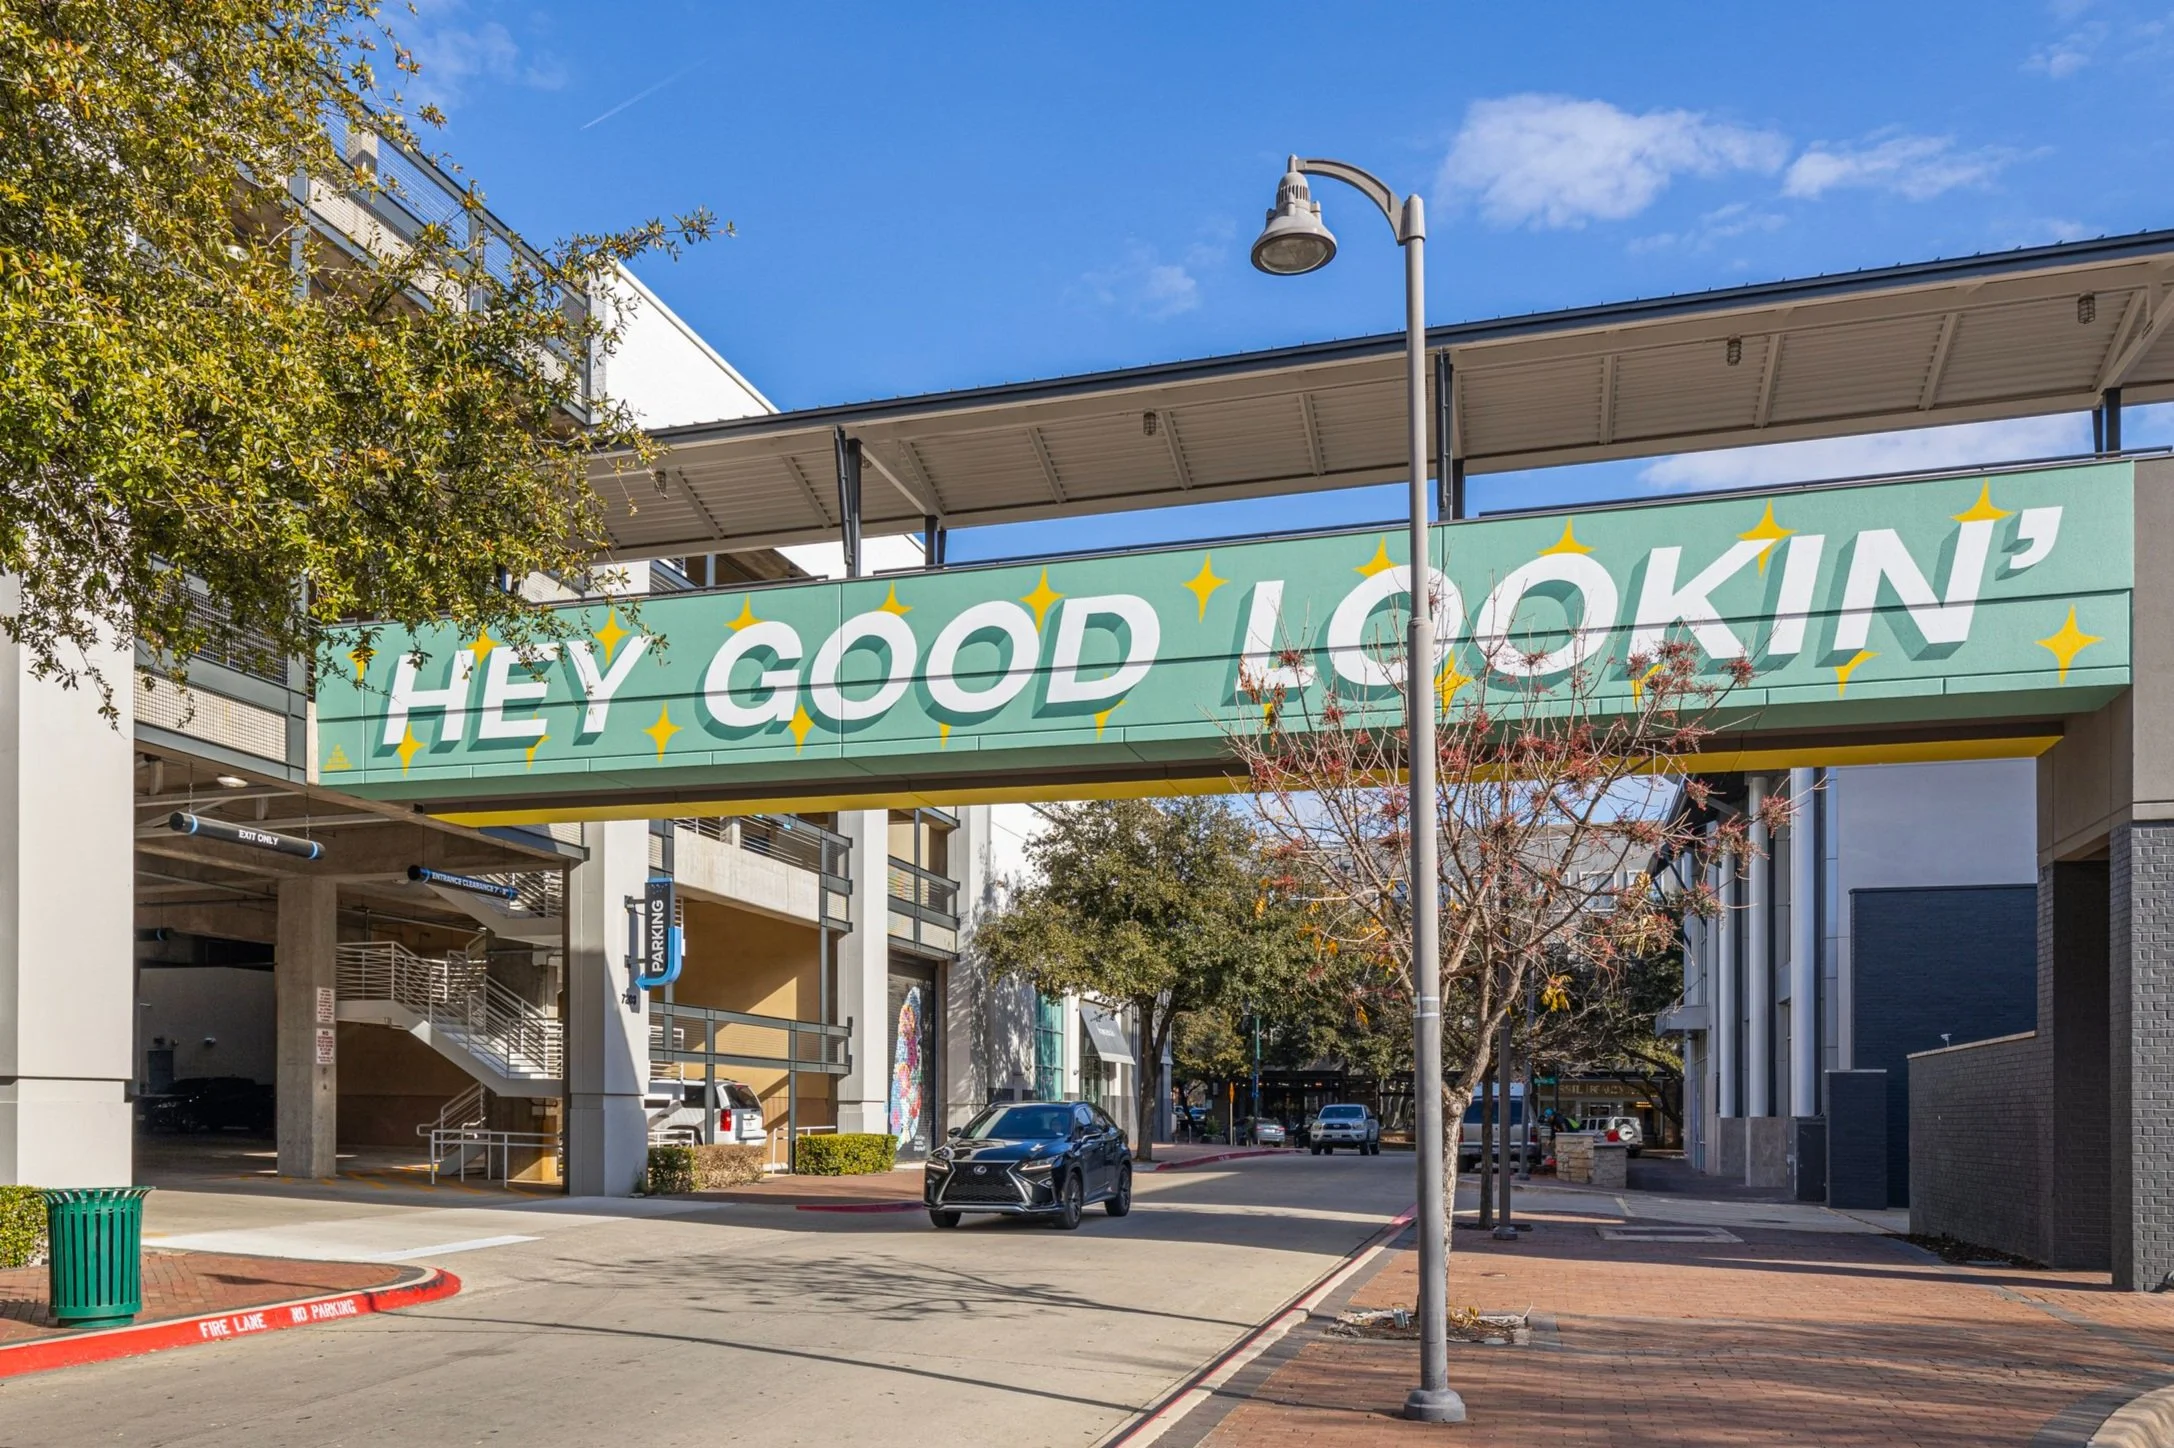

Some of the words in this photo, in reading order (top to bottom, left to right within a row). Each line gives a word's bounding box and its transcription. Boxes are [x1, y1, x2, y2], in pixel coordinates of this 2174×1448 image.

[382, 635, 652, 745] HEY
[703, 593, 1161, 728] GOOD
[238, 829, 257, 841] EXIT
[257, 833, 279, 846] ONLY
[431, 871, 462, 886] ENTRANCE
[462, 878, 494, 893] CLEARANCE
[651, 899, 664, 972] PARKING
[199, 1319, 231, 1338] FIRE
[233, 1313, 268, 1332] LANE
[290, 1306, 308, 1323] NO
[311, 1299, 357, 1319] PARKING
